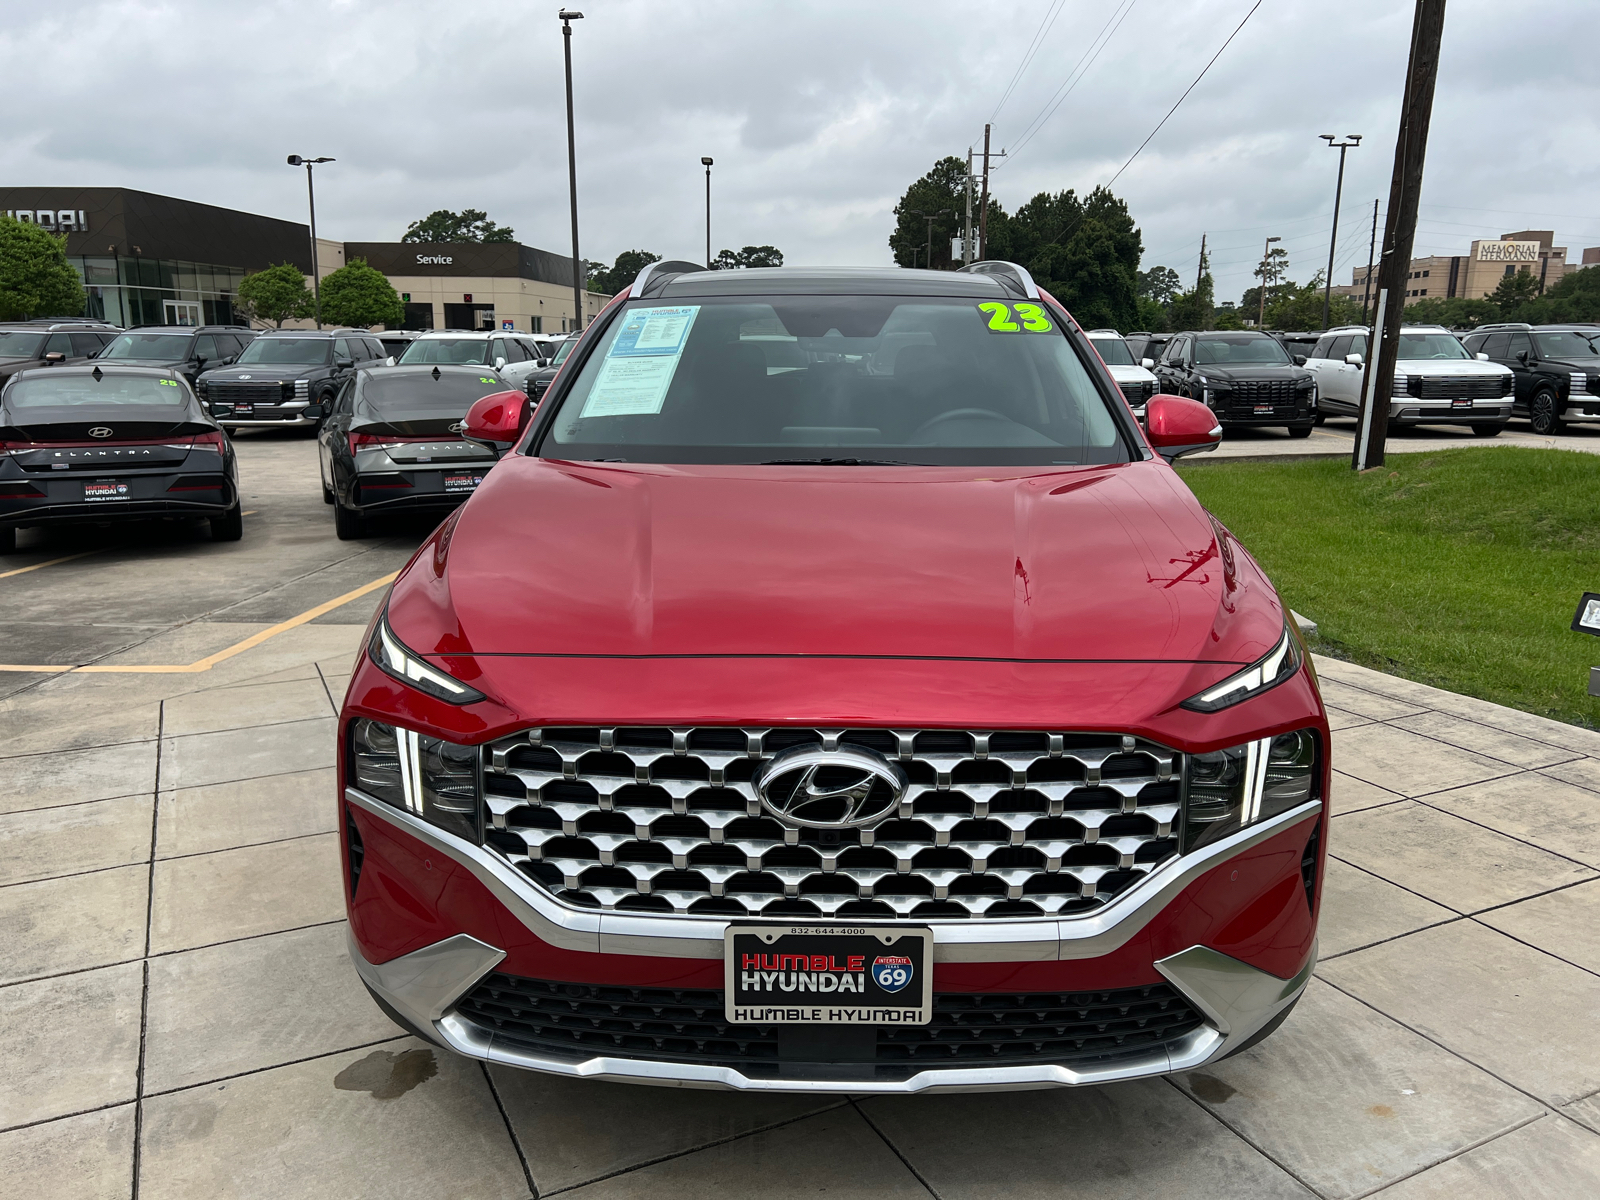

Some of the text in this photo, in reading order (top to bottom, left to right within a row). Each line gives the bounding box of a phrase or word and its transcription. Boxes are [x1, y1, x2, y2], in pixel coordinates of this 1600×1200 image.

[1482, 244, 1537, 254] MEMORIAL
[416, 254, 453, 265] Service
[1480, 251, 1536, 260] HERMANN
[978, 302, 1053, 332] 23
[160, 379, 177, 387] 25
[54, 449, 150, 457] ELANTRA
[790, 927, 866, 935] 832-644-4000
[742, 953, 866, 972] HUMBLE
[741, 971, 865, 993] HYUNDAI
[879, 969, 907, 986] 69
[734, 1009, 923, 1022] HUMBLE HYUNDAI
